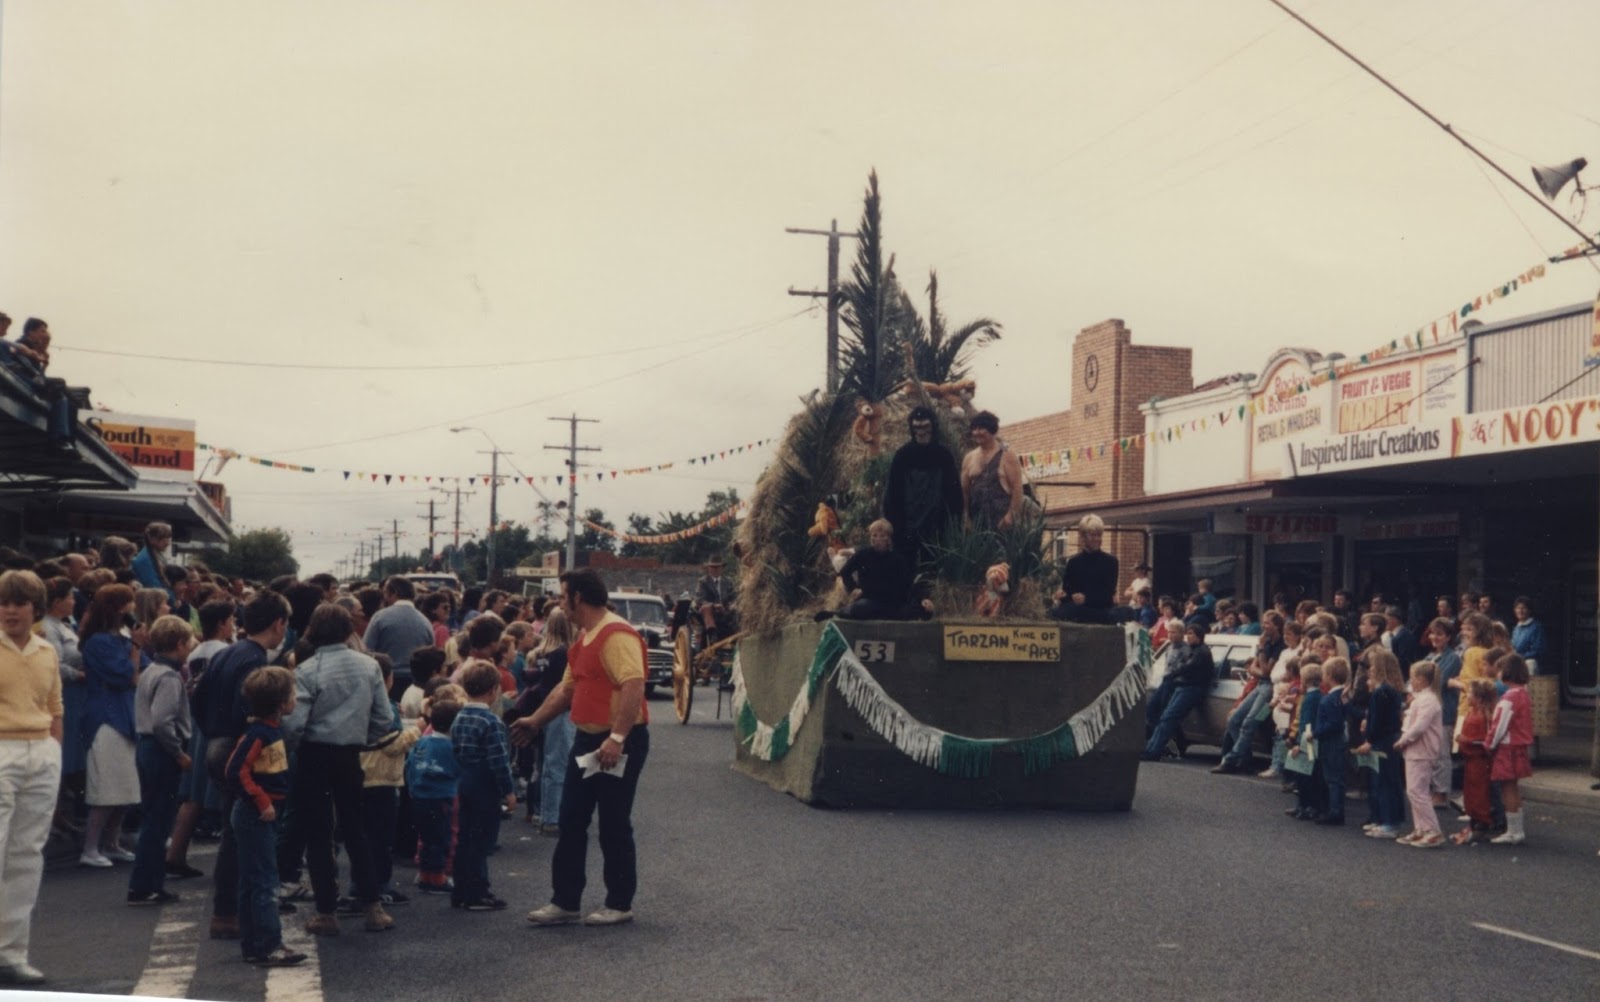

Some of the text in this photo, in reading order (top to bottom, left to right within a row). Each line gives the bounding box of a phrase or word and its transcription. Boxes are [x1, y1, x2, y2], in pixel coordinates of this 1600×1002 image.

[1342, 379, 1369, 400] FRUIT
[1371, 376, 1379, 394] &
[1382, 370, 1411, 392] VEGIE
[1300, 426, 1440, 471] Inspired Hair Creations
[946, 630, 1009, 648] TARZAN
[1041, 632, 1056, 641] OF
[859, 643, 887, 661] 53
[1013, 643, 1060, 660] THE APES
